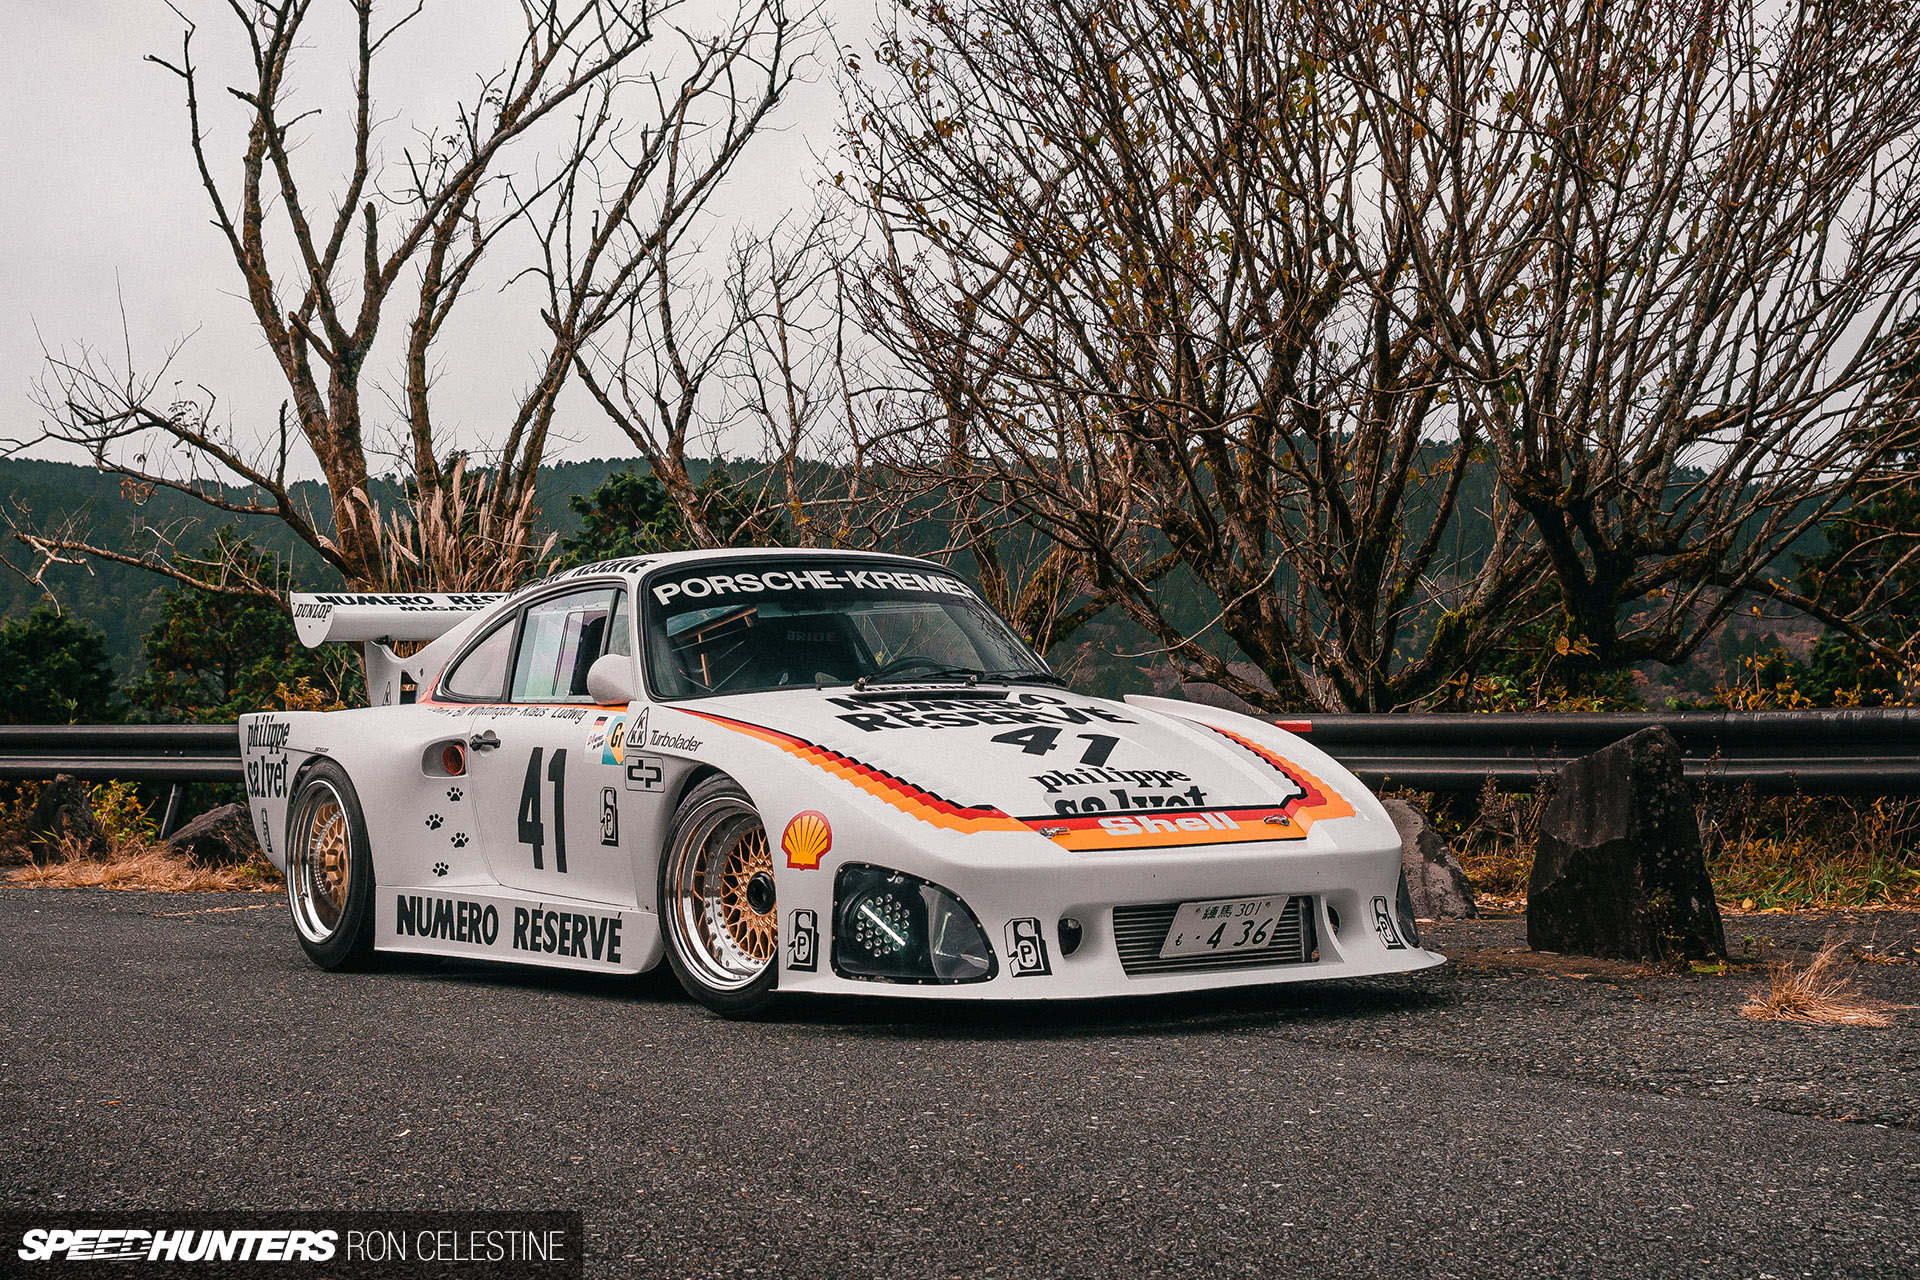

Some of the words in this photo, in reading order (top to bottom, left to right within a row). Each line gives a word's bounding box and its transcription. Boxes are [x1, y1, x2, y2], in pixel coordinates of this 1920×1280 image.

[315, 595, 434, 605] NUMERO
[652, 570, 977, 605] PORSCHE-KREMER
[294, 603, 333, 618] DUNLOP
[550, 707, 588, 724] Ludwig
[246, 714, 291, 755] philippe
[650, 729, 704, 752] Turbolader
[990, 725, 1121, 767] 41
[247, 752, 289, 799] salvet
[1029, 766, 1192, 793] philippe
[517, 746, 568, 874] 41
[1097, 812, 1241, 836] Shell
[396, 894, 499, 946] NUMERO
[512, 902, 623, 964] RÉSERVÉ
